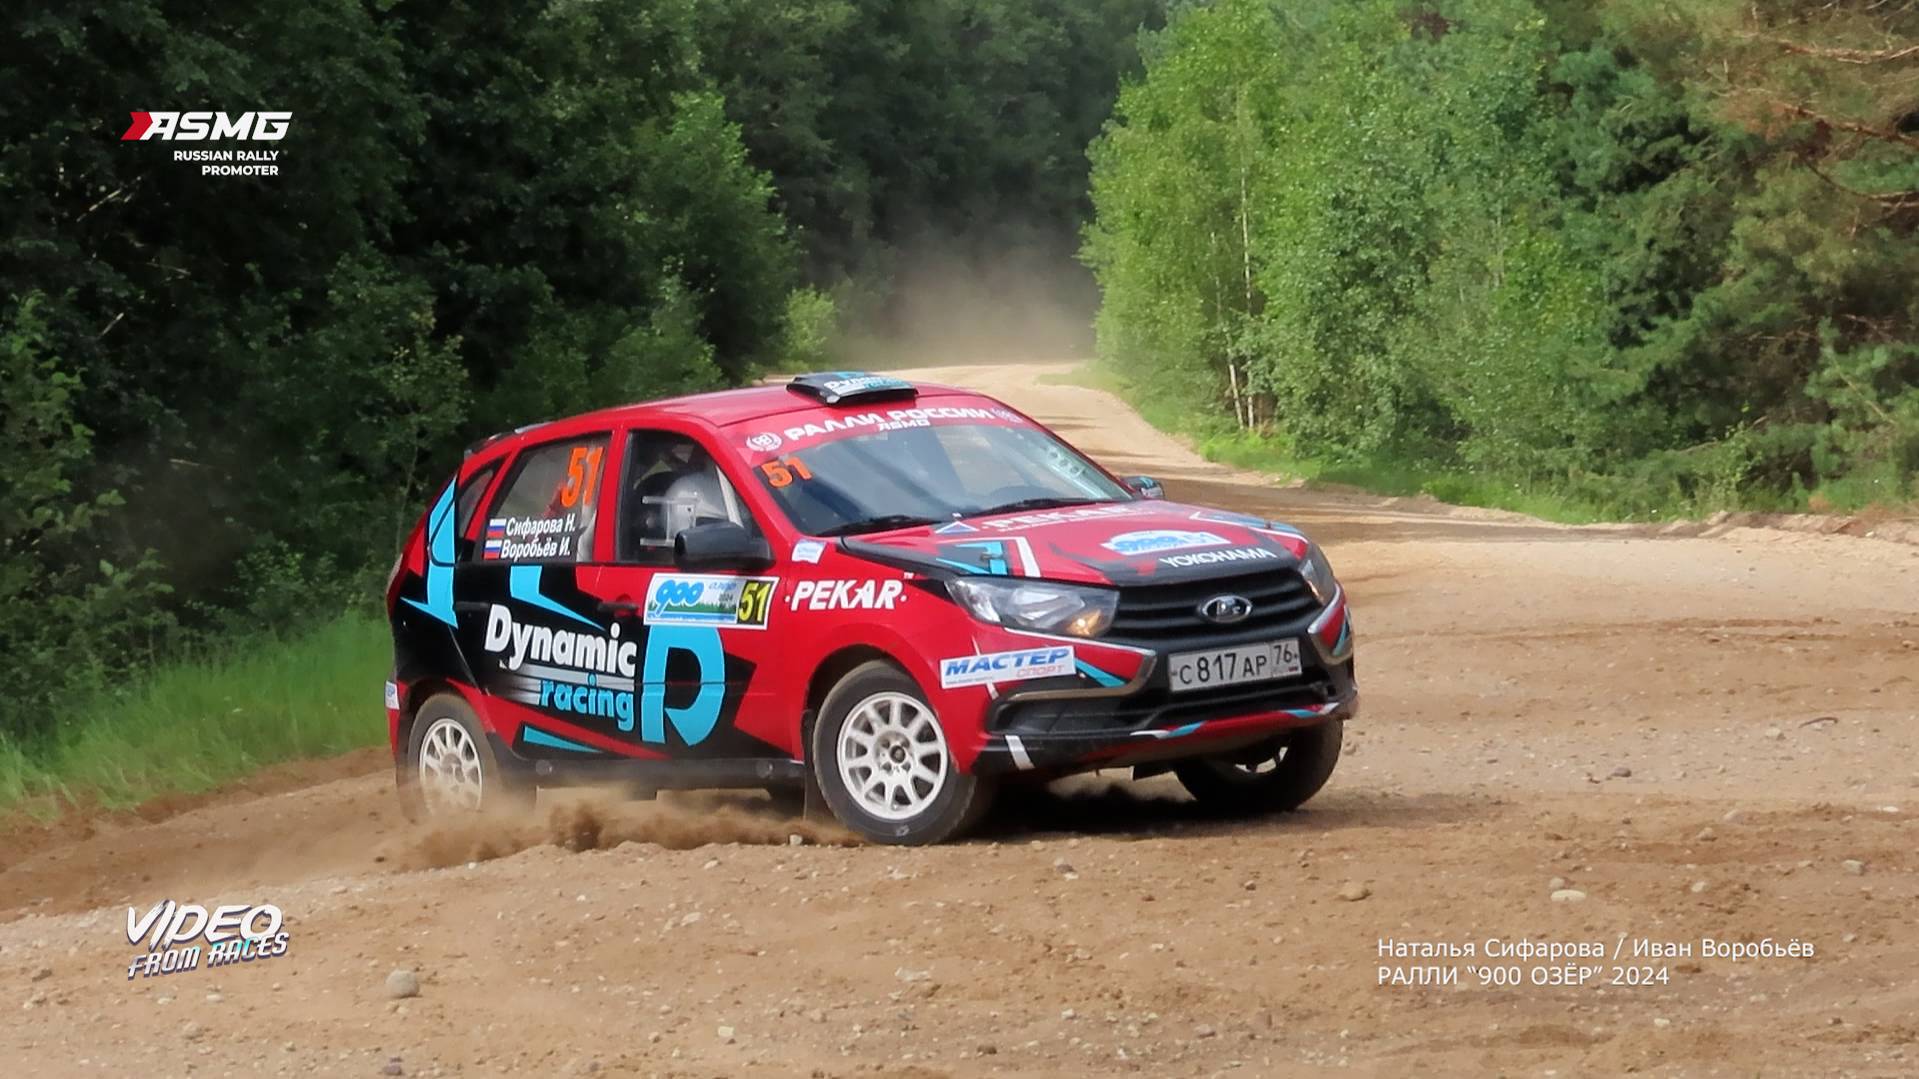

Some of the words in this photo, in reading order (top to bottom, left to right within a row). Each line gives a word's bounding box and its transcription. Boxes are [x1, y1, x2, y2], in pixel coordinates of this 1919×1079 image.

[784, 412, 883, 442] РАЛЛИ
[885, 406, 995, 423] РОССИИ
[561, 446, 604, 508] 51
[760, 456, 813, 489] 51
[505, 516, 564, 540] Сифарова
[564, 512, 576, 532] Н.
[500, 536, 557, 562] Воробьёв
[559, 536, 571, 556] И.
[1158, 547, 1278, 568] YOKOHAMA
[655, 580, 704, 617] 900
[738, 581, 771, 623] 51
[790, 579, 904, 612] PEKAR
[484, 603, 638, 678] Dynamic
[1273, 643, 1293, 665] 76
[945, 648, 1070, 677] МАСТЕР
[1015, 664, 1066, 679] СПОРТ
[539, 673, 635, 731] racing
